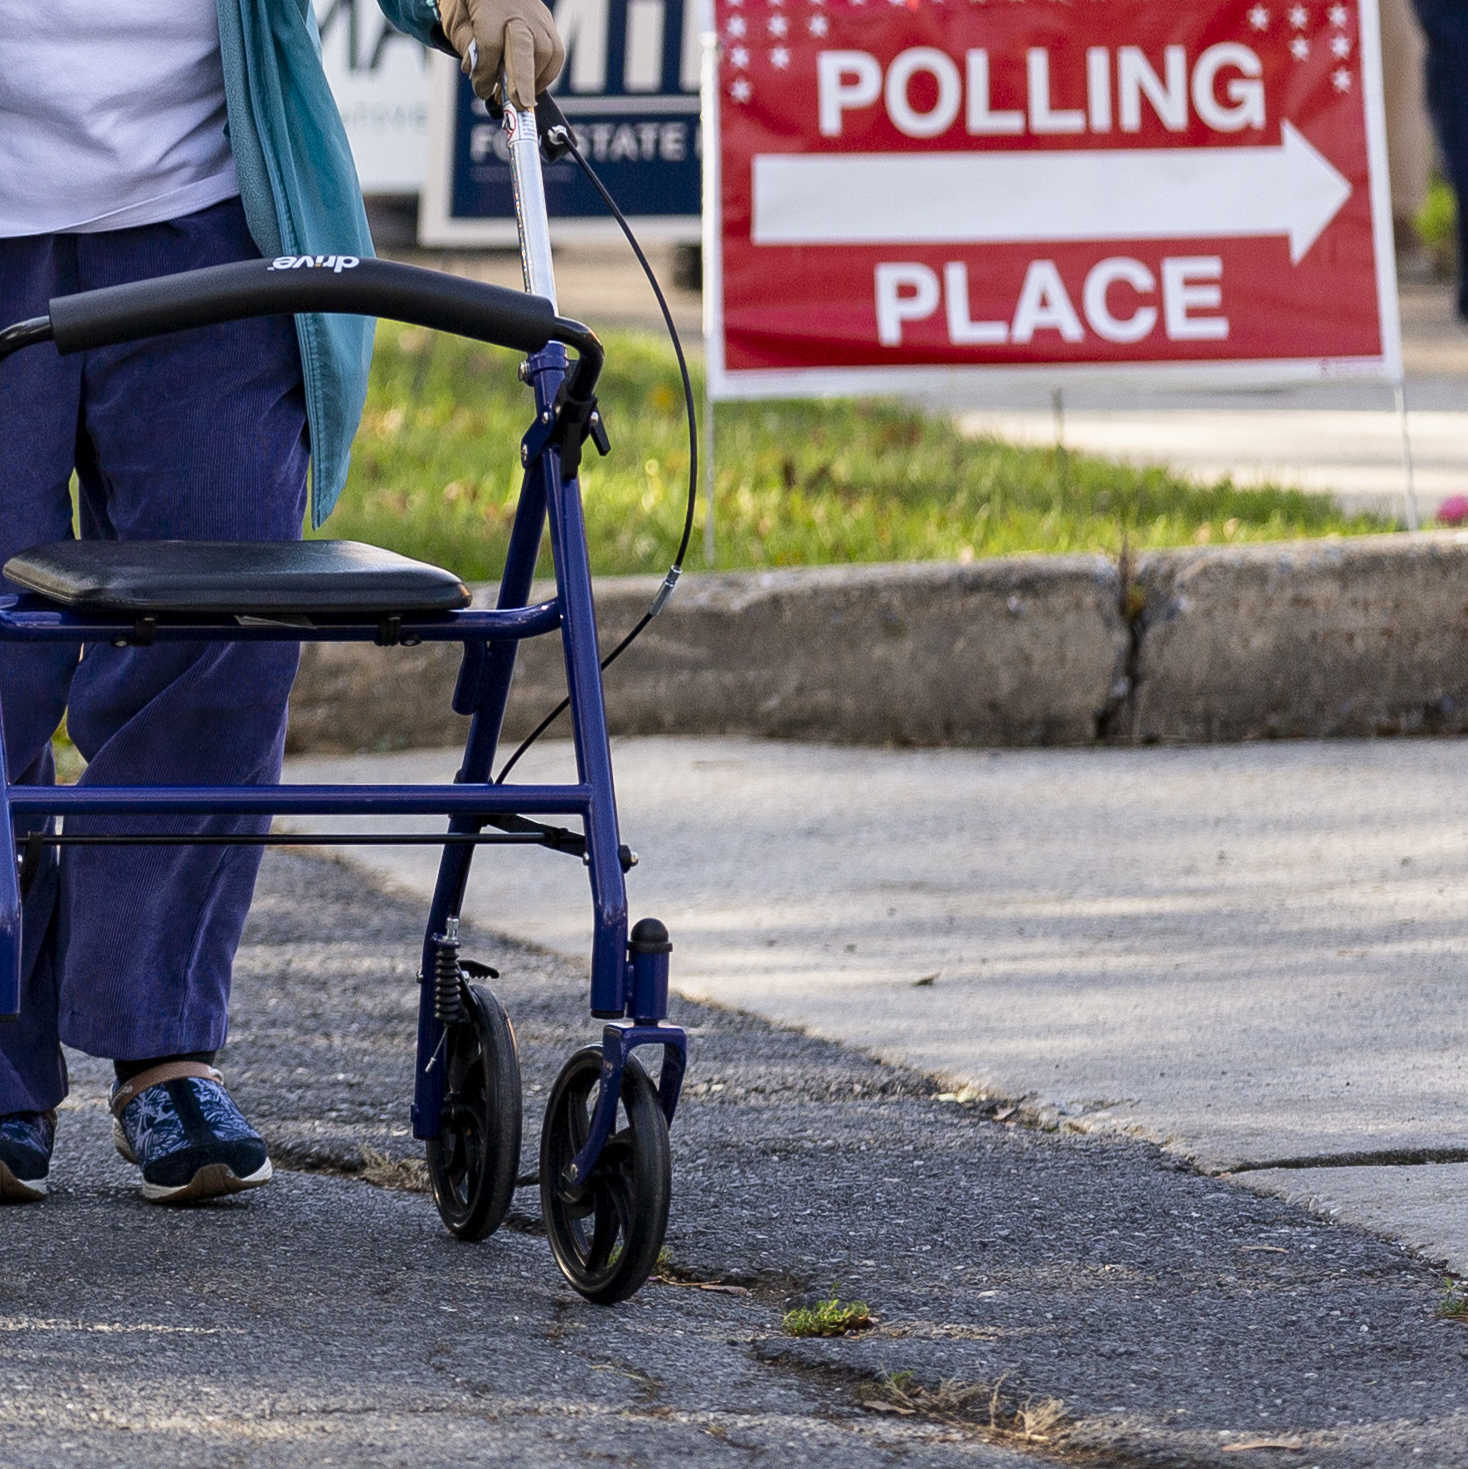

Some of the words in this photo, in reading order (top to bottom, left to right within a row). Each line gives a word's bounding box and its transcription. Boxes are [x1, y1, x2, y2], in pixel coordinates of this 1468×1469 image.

[817, 41, 1266, 138] POLLING
[272, 255, 360, 273] drive
[874, 254, 1230, 348] PLACE
